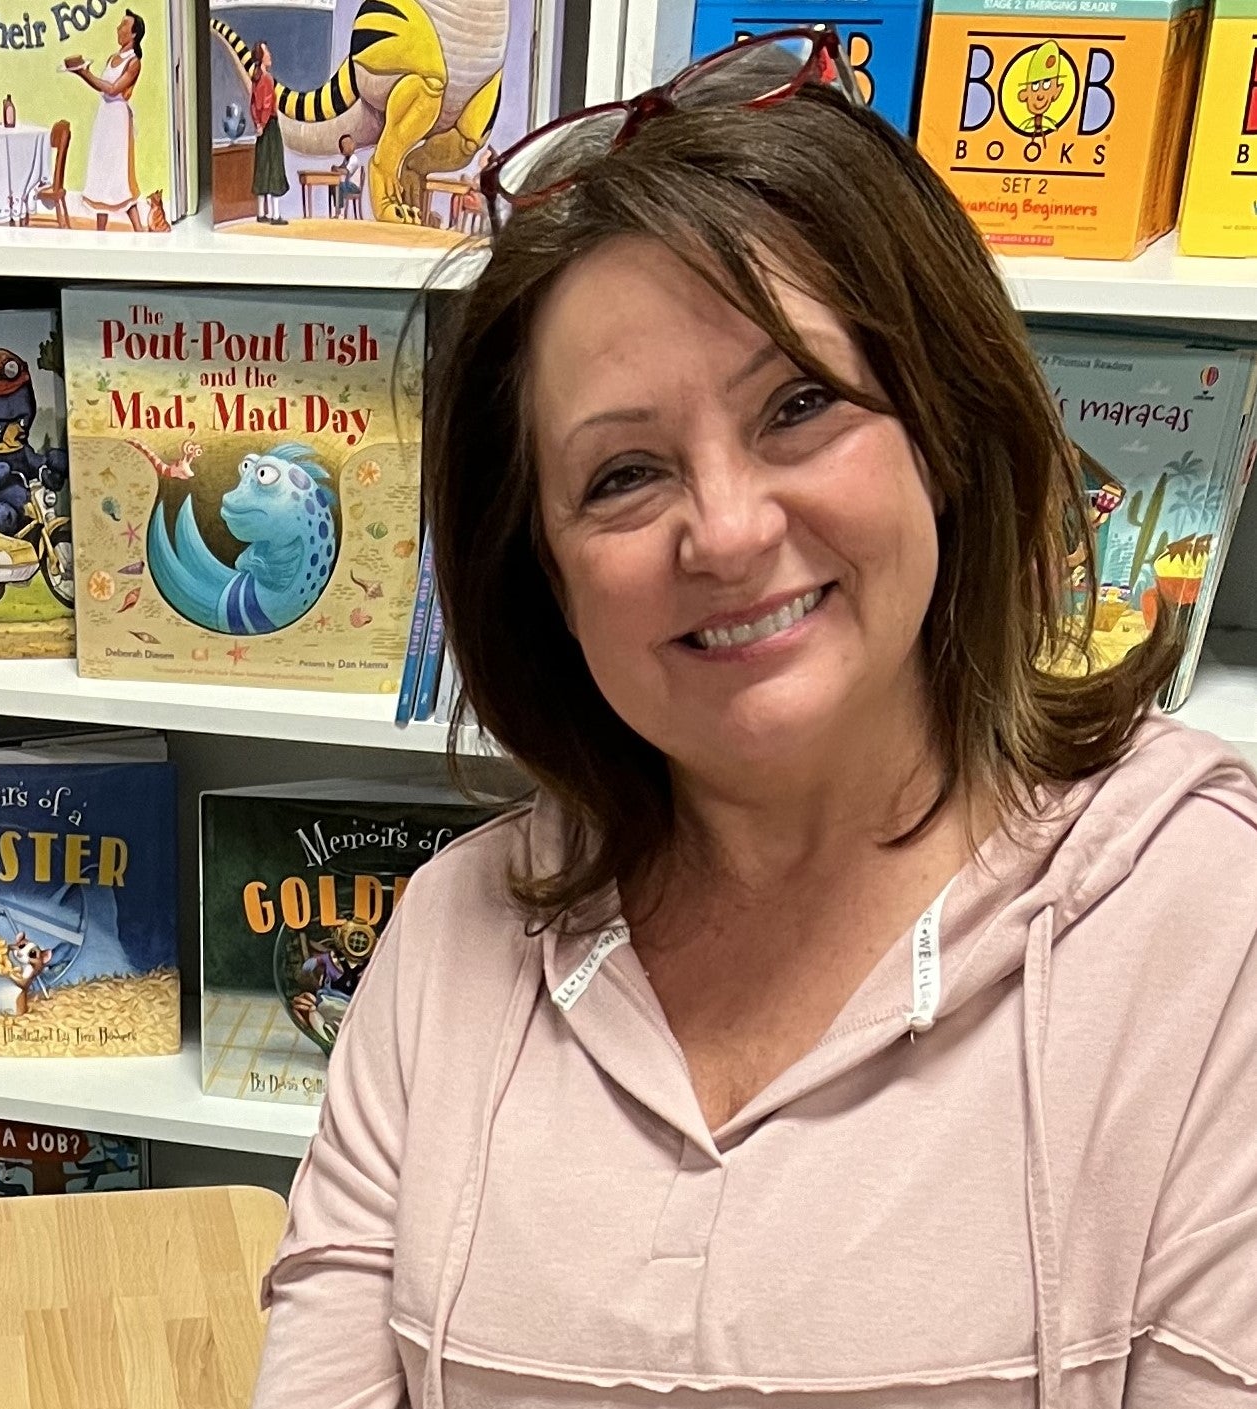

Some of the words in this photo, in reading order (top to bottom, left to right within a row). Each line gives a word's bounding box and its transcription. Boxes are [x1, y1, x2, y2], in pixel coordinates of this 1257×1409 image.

[1025, 0, 1077, 11] EMERGING
[1079, 2, 1118, 12] READER
[50, 0, 119, 42] Foo
[959, 43, 1116, 137] BOB
[954, 139, 1106, 165] BOOKS
[1001, 176, 1032, 194] SET
[1038, 178, 1049, 195] 2
[962, 197, 1018, 220] vancing
[1022, 199, 1098, 221] Beginners
[128, 304, 164, 325] The
[97, 319, 290, 362] Pout-Pout
[299, 322, 379, 367] Fish
[199, 366, 237, 388] and
[245, 366, 279, 389] the
[107, 390, 197, 437] Mad,
[211, 391, 291, 433] Mad
[303, 394, 375, 446] Day
[1080, 398, 1194, 433] maracas
[105, 647, 143, 659] Deborah
[338, 659, 357, 669] Dan
[38, 786, 72, 817] of
[68, 801, 88, 827] a
[294, 818, 409, 868] Memoirs
[2, 1127, 17, 1148] A
[27, 1131, 80, 1155] JOB?
